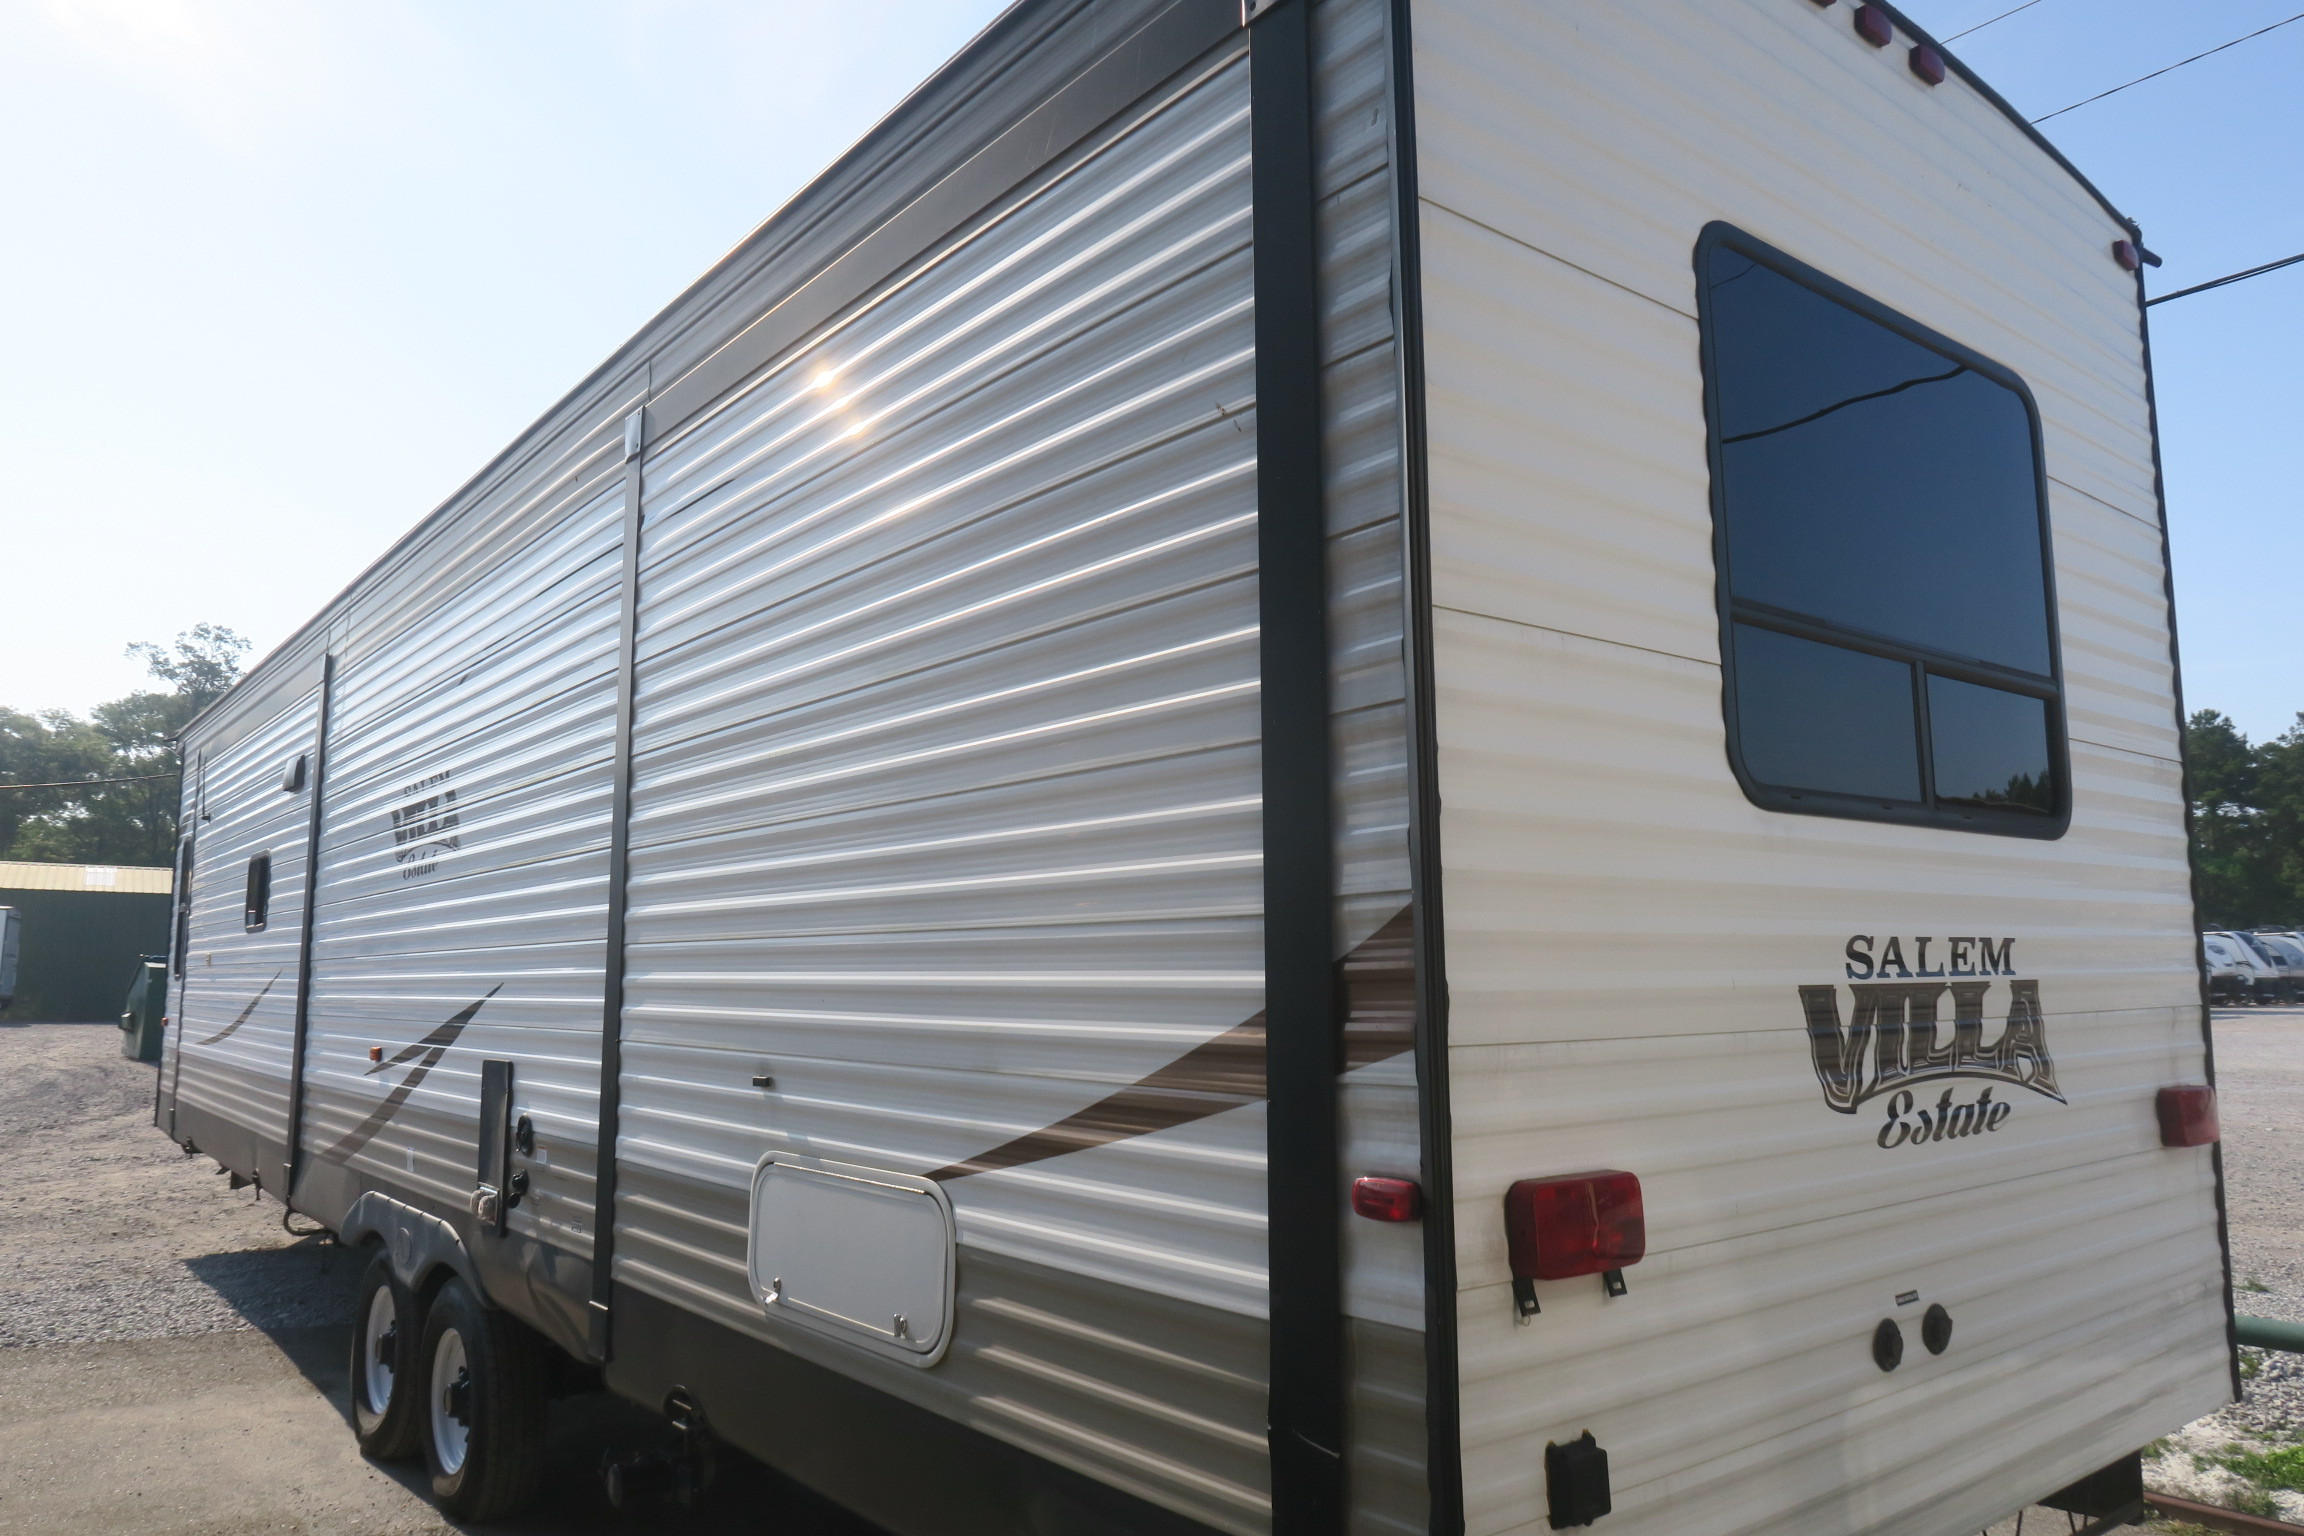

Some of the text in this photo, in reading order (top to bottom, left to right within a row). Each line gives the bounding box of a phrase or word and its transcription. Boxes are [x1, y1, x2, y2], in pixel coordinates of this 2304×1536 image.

[1845, 935, 2016, 980] SALEM
[1798, 979, 2068, 1115] VILLA
[1877, 1086, 2011, 1149] Estate
